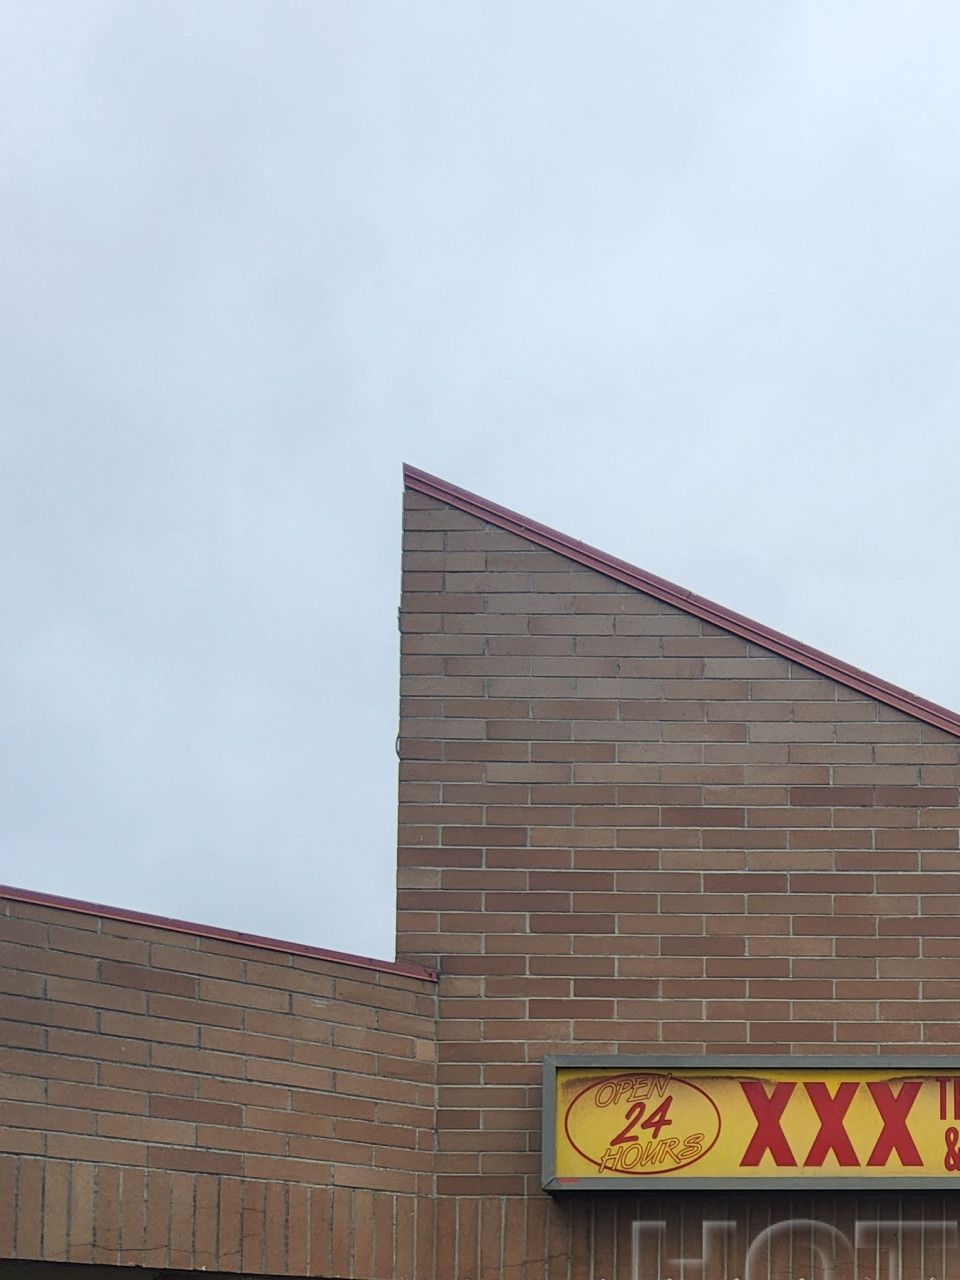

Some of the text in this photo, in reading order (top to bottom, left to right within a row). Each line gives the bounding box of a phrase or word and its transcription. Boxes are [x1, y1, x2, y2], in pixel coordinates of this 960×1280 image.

[594, 1072, 673, 1109] OPEN
[609, 1094, 673, 1147] 24
[738, 1081, 925, 1167] XXX
[598, 1132, 705, 1174] HOURS
